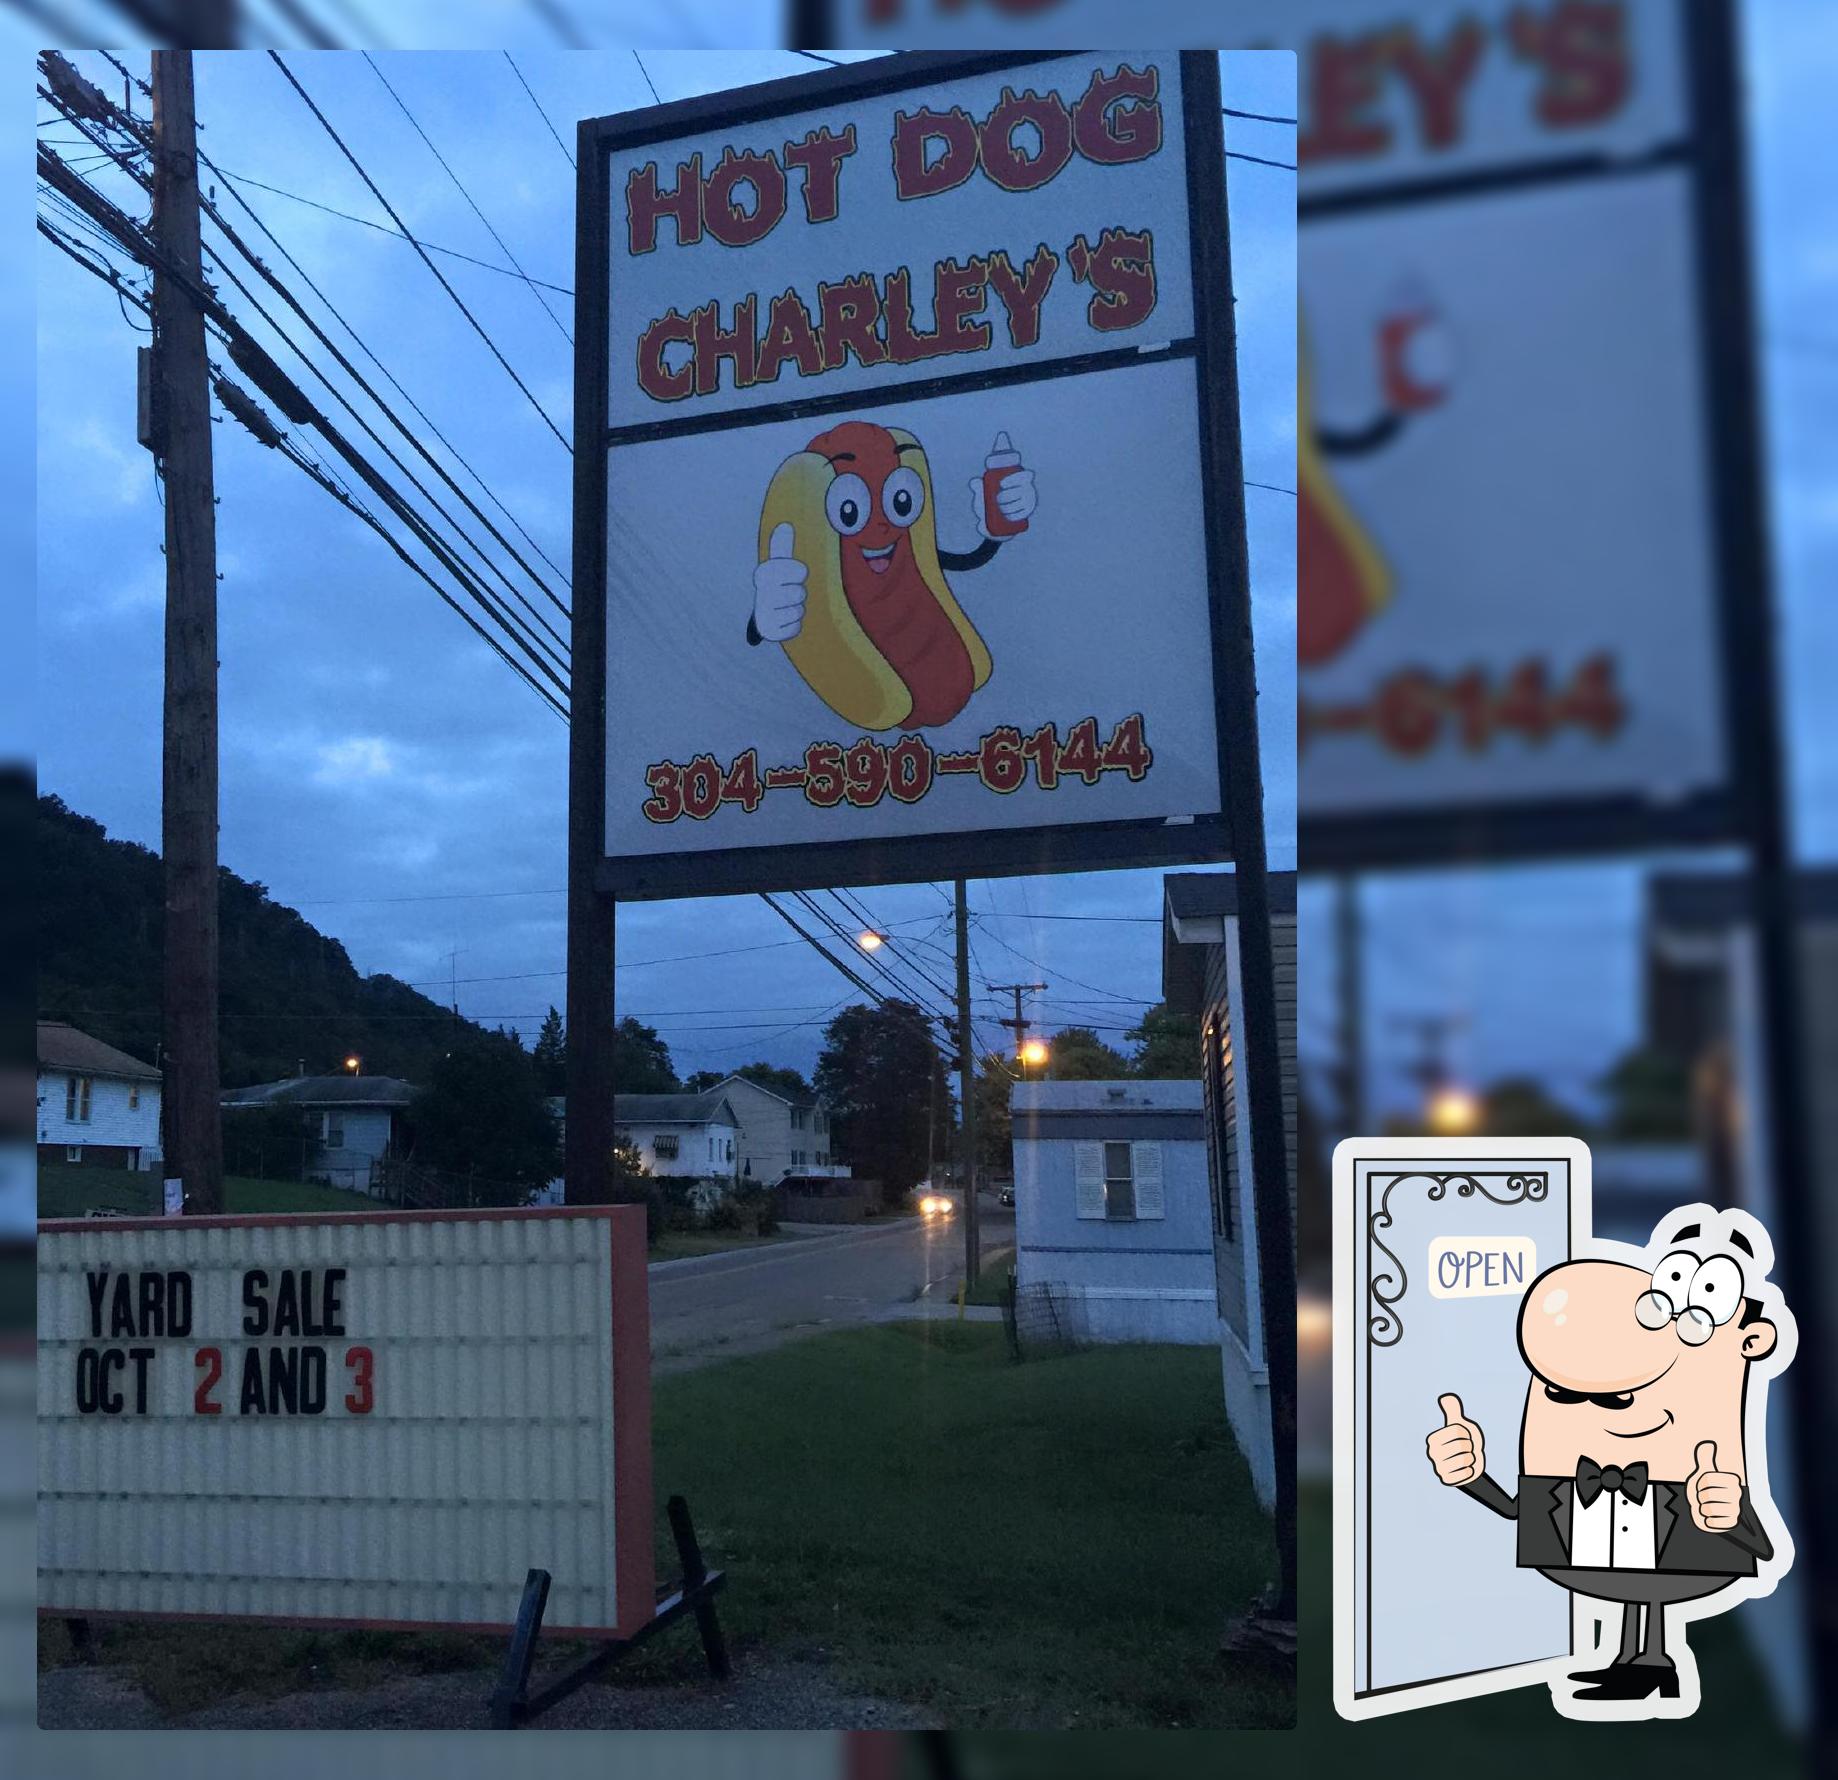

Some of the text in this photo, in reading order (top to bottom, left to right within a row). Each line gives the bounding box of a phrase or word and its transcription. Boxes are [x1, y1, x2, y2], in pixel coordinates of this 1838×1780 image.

[625, 124, 856, 255] HOT
[891, 64, 1162, 201] DOG
[636, 227, 1157, 403] CHARLEY'S
[643, 714, 1152, 822] 304-590-6144
[86, 1268, 346, 1338] YARD SALE
[76, 1346, 373, 1414] OCT 2 AND 3
